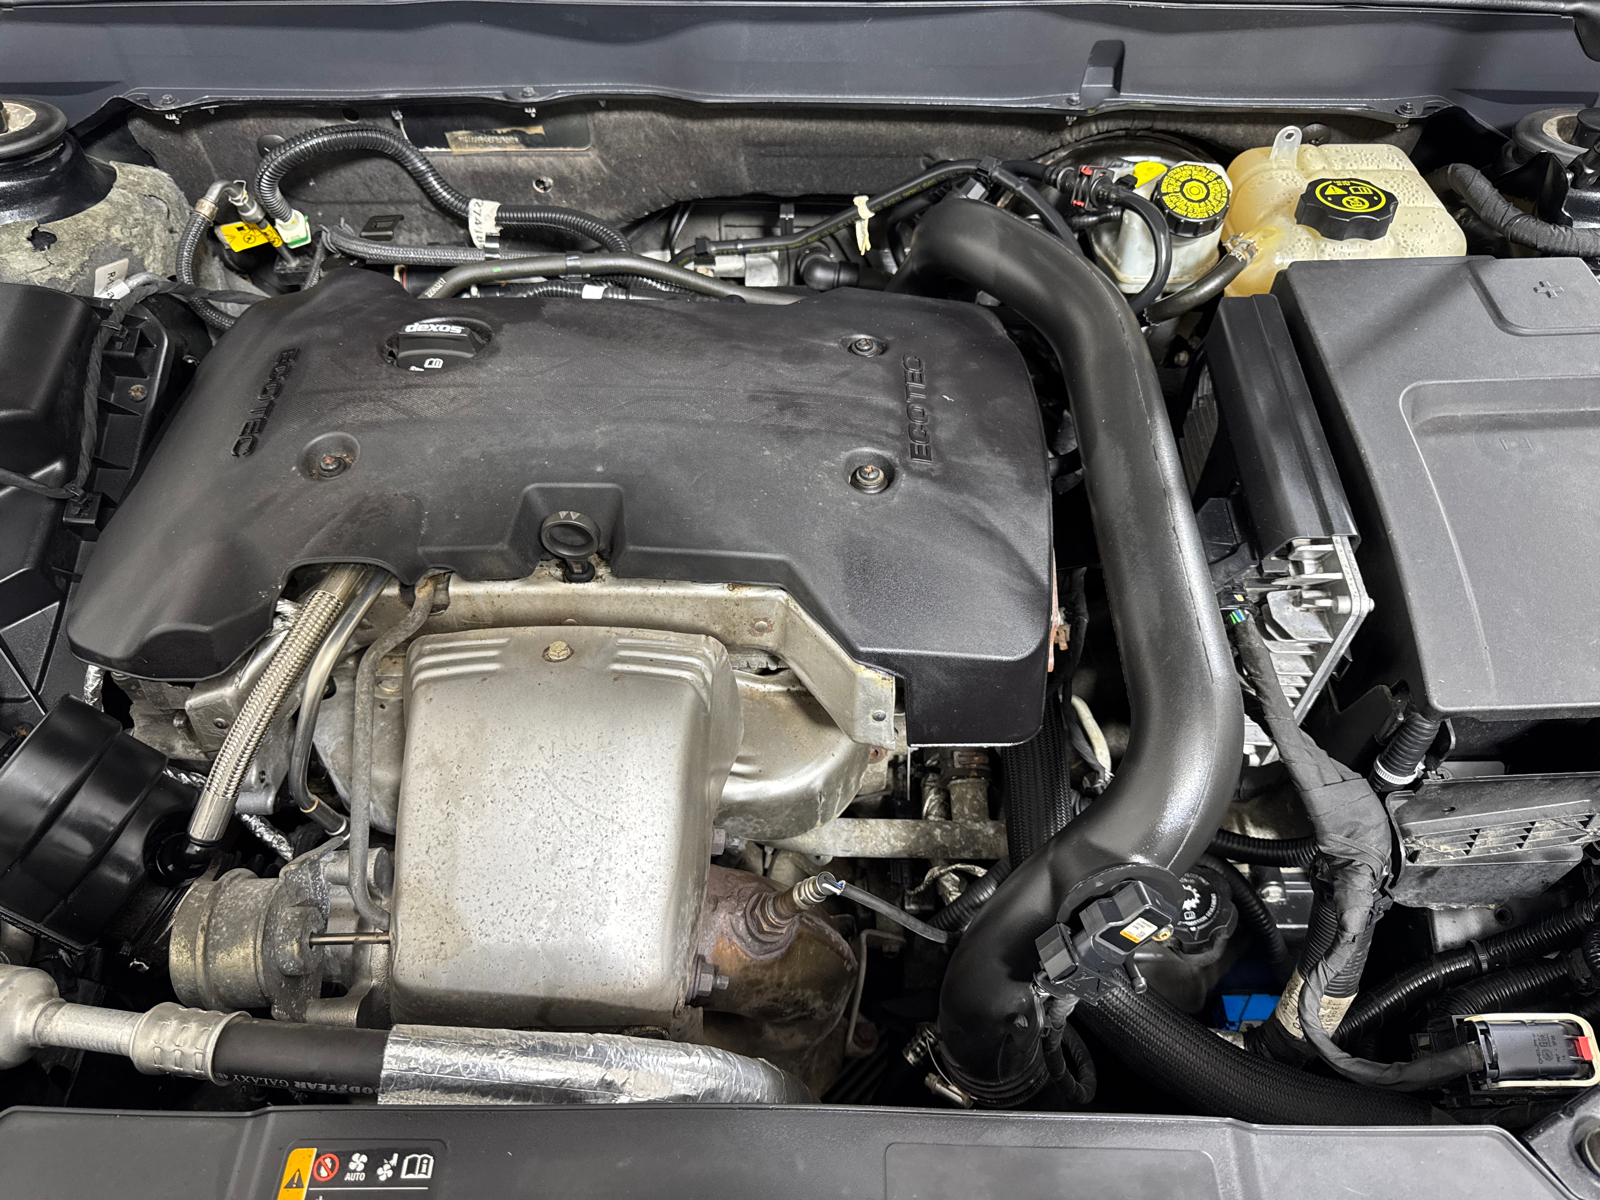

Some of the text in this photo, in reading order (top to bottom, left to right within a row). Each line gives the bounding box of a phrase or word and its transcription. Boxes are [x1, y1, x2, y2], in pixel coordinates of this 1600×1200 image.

[405, 322, 465, 334] dexos
[231, 347, 301, 457] ECOTEC
[902, 353, 932, 464] ECOTEC
[233, 1074, 289, 1087] GALAXY
[294, 1081, 381, 1095] OODYEAR
[344, 1172, 366, 1182] AUTO
